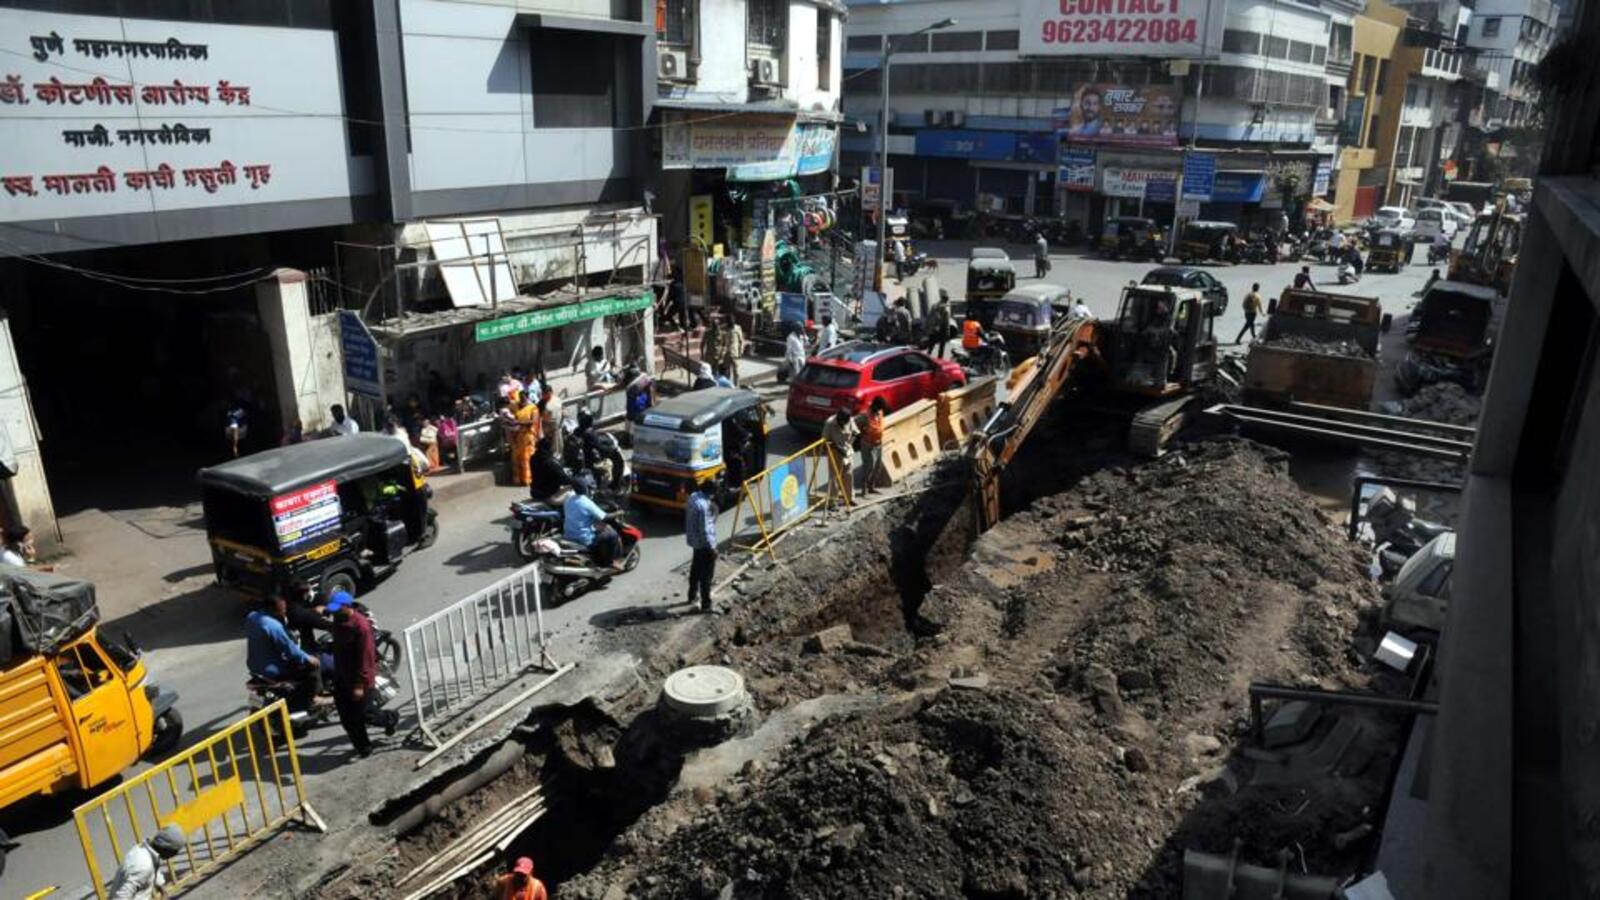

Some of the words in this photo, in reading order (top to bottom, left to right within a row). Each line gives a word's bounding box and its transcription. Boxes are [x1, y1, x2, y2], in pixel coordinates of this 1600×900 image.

[1059, 0, 1179, 15] CONTACT
[1041, 19, 1198, 43] 9623422084
[29, 31, 64, 62] पुणे
[72, 37, 208, 61] महानगरपालिका
[0, 74, 30, 105] डॉ.
[33, 77, 134, 105] कोटणीस
[140, 80, 210, 105] आरोग्य
[216, 80, 251, 105] केंद्र
[116, 123, 211, 146] नगरसेविका
[1, 175, 38, 197] स्व.
[42, 165, 116, 195] मालती
[123, 163, 176, 191] काची
[243, 164, 271, 189] गृह
